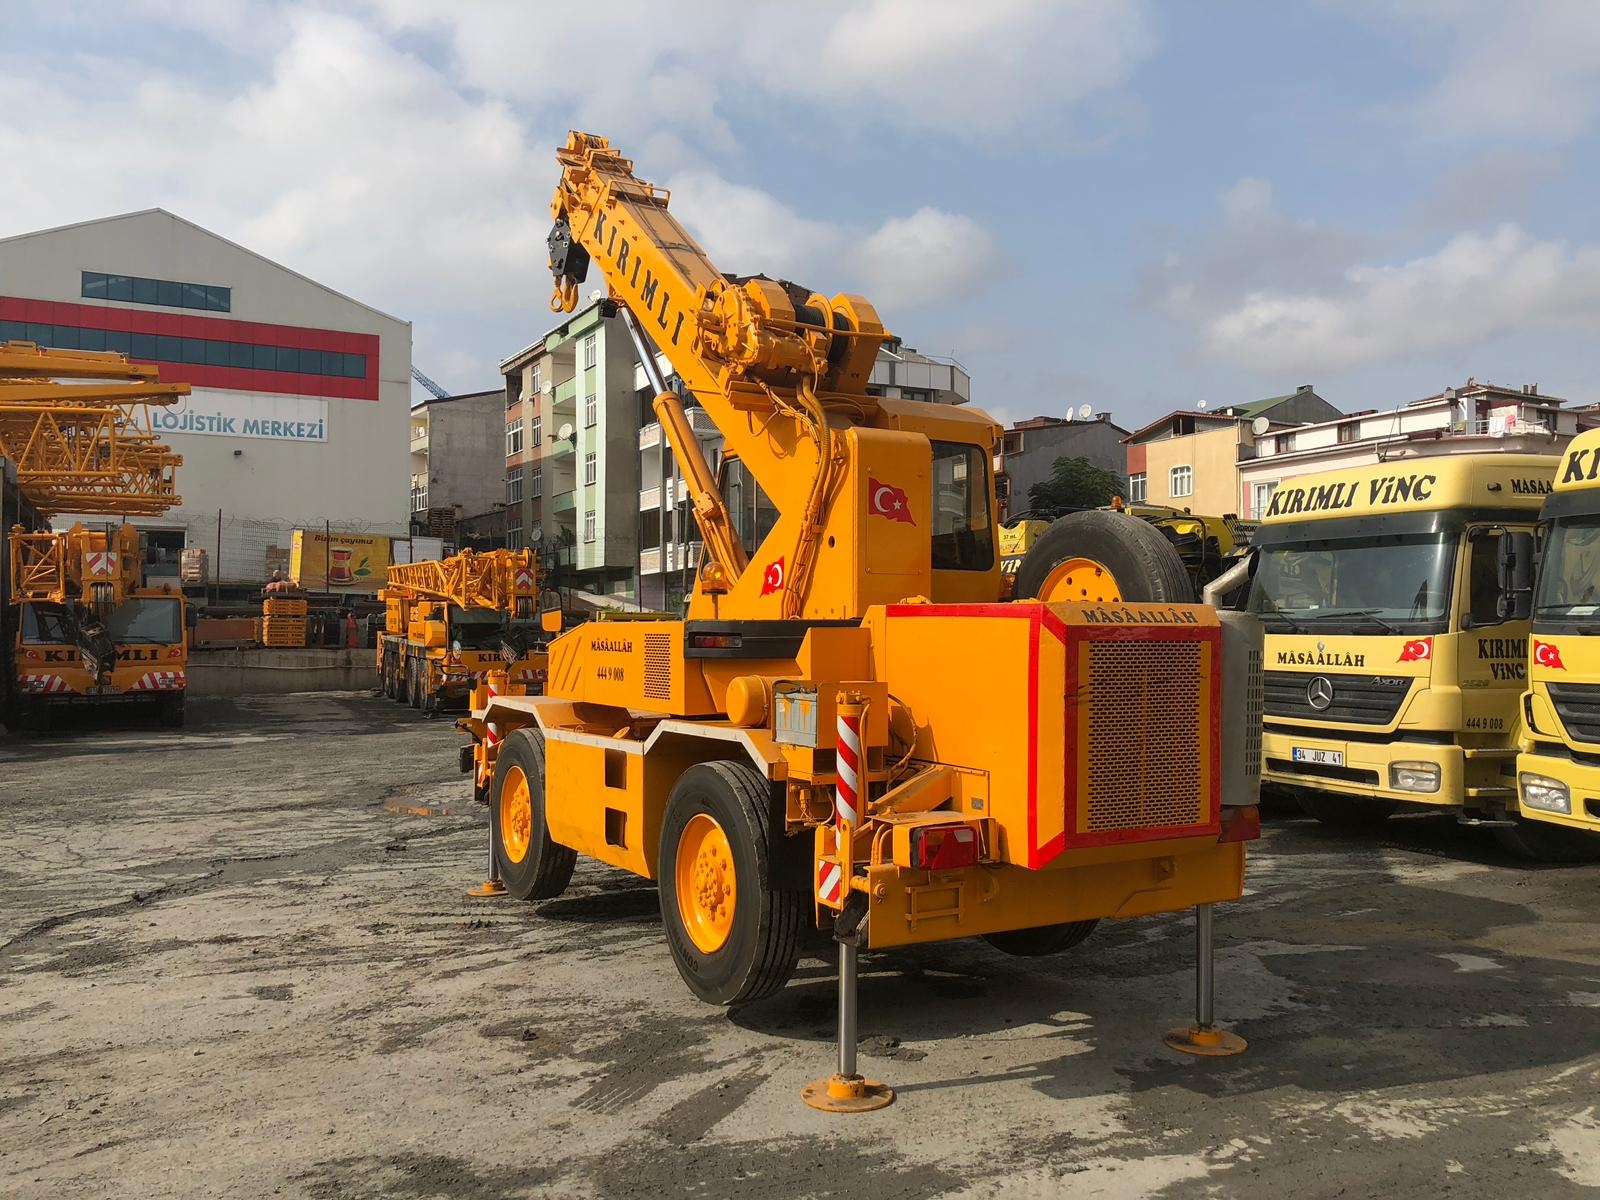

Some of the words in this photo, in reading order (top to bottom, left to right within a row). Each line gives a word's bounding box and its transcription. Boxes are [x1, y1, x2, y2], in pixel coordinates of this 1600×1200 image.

[593, 208, 685, 346] KIRIMLI
[153, 409, 236, 434] LOJİSTİK
[242, 418, 324, 440] MERKEZİ
[1266, 481, 1360, 518] KIRIMLI
[1081, 606, 1199, 624] MÂSÂALLÂH
[590, 637, 633, 653] MÂSÂALLÂH
[1478, 638, 1529, 659] KIRIML
[45, 650, 159, 662] KIMLI
[597, 666, 607, 680] 444
[608, 667, 612, 681] 9
[613, 667, 624, 682] 008
[1466, 717, 1481, 729] 444
[1482, 717, 1487, 728] 9
[1489, 718, 1504, 730] 008
[1297, 749, 1306, 760] 34
[1312, 751, 1326, 762] JUZ
[1332, 753, 1342, 764] 41
